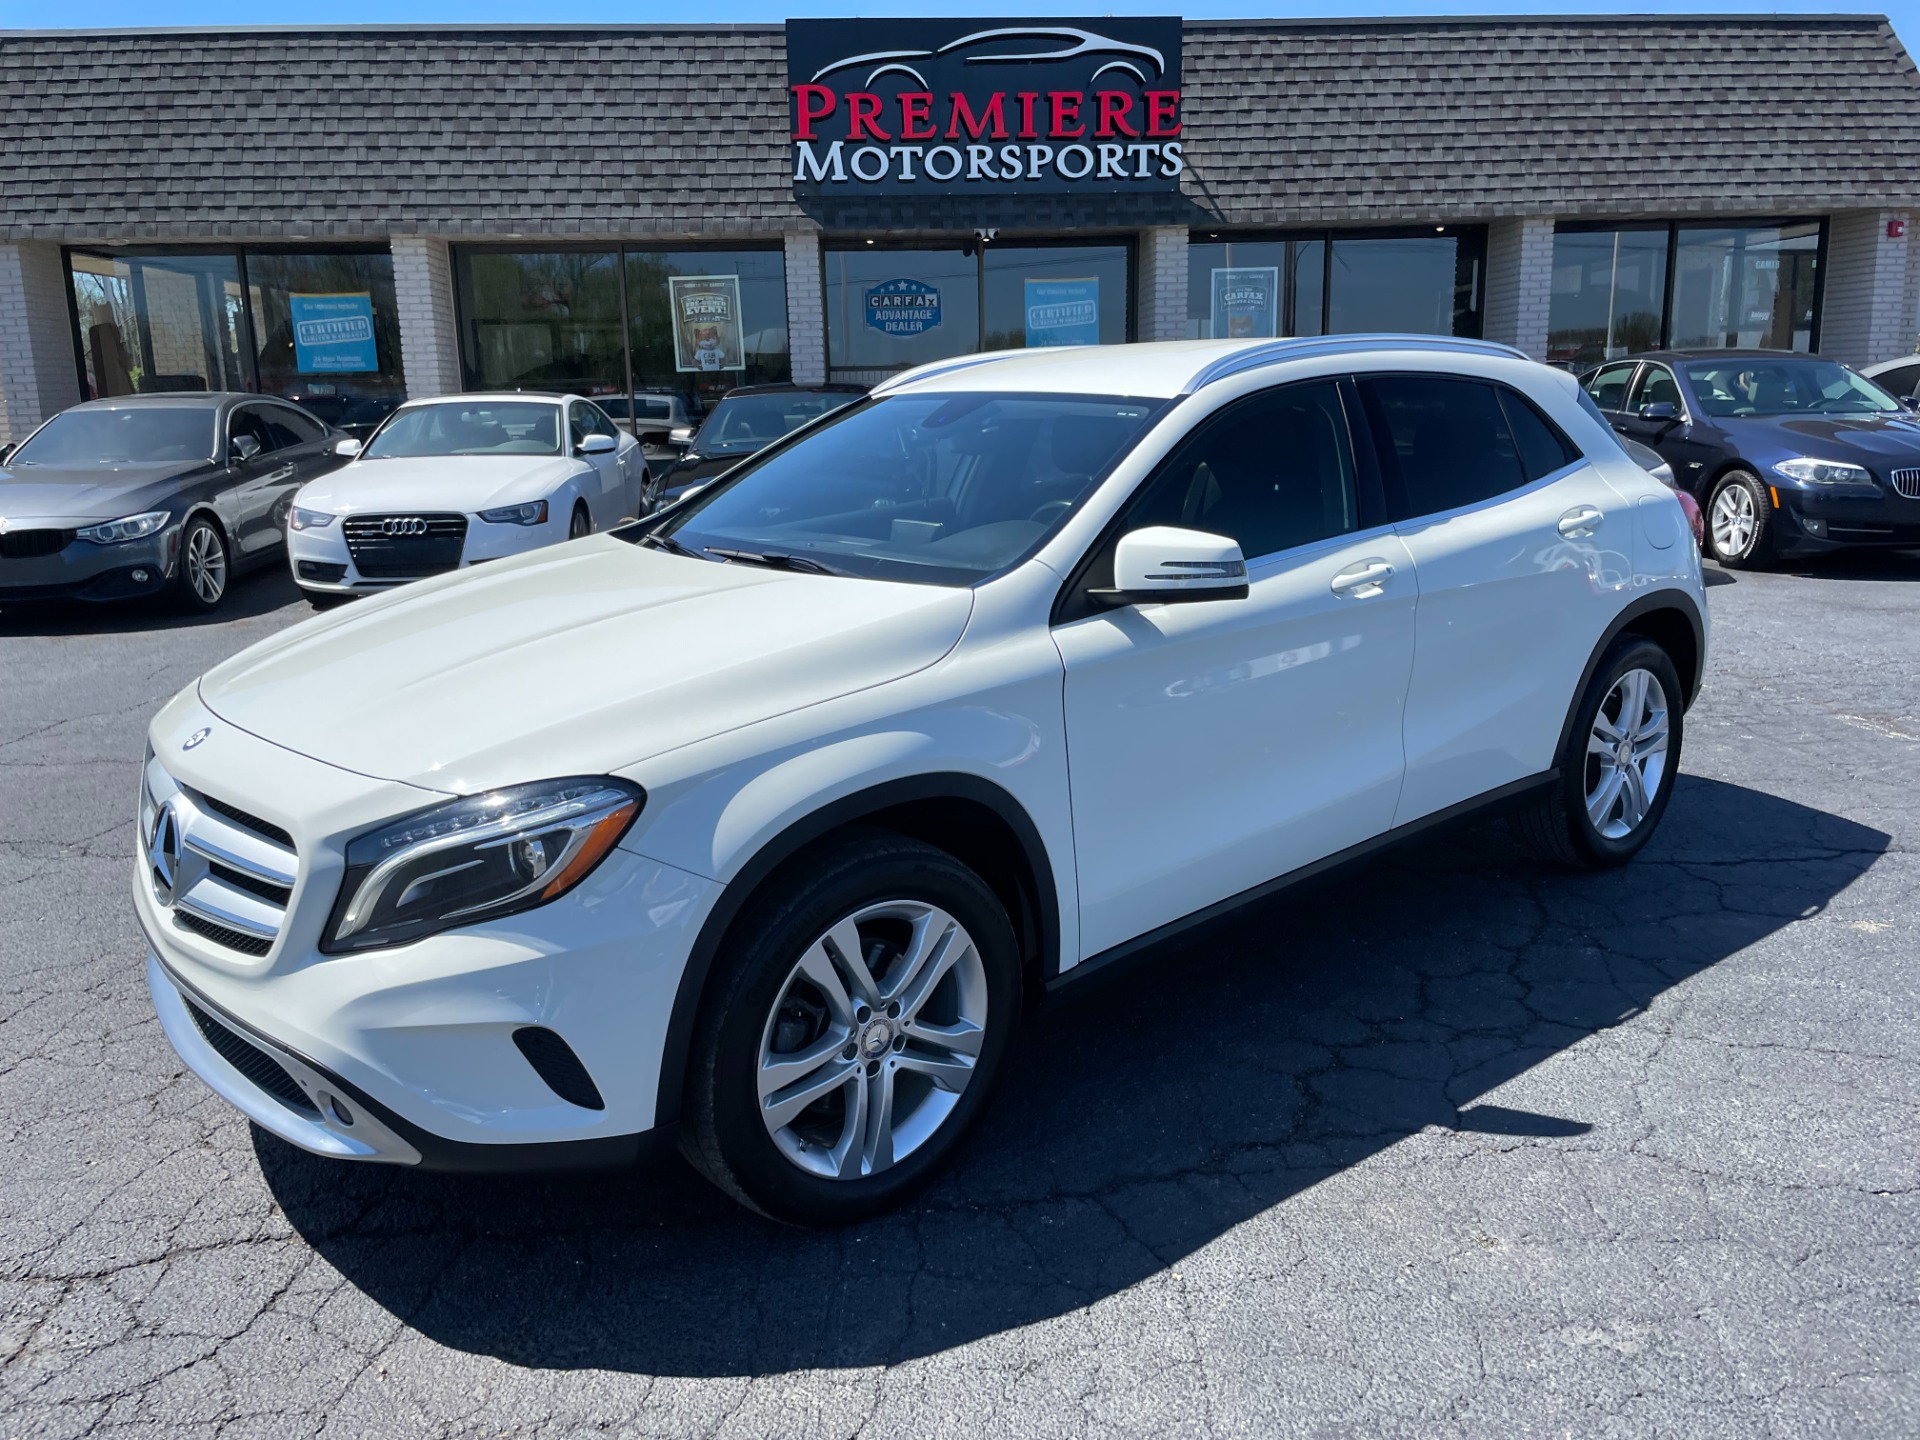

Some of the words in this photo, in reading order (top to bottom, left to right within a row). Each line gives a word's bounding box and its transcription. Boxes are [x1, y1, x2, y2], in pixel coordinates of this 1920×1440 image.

[791, 85, 1183, 141] PREMIERE
[793, 141, 1184, 182] MOTORSPORTS
[871, 296, 935, 307] CARFAX
[1224, 292, 1264, 301] CARFAX
[686, 305, 727, 315] EVENT!
[875, 310, 933, 320] ADVANTAGE
[1032, 305, 1092, 319] CERTIFIED
[301, 320, 366, 335] CERTIFIED
[885, 321, 923, 332] DEALER
